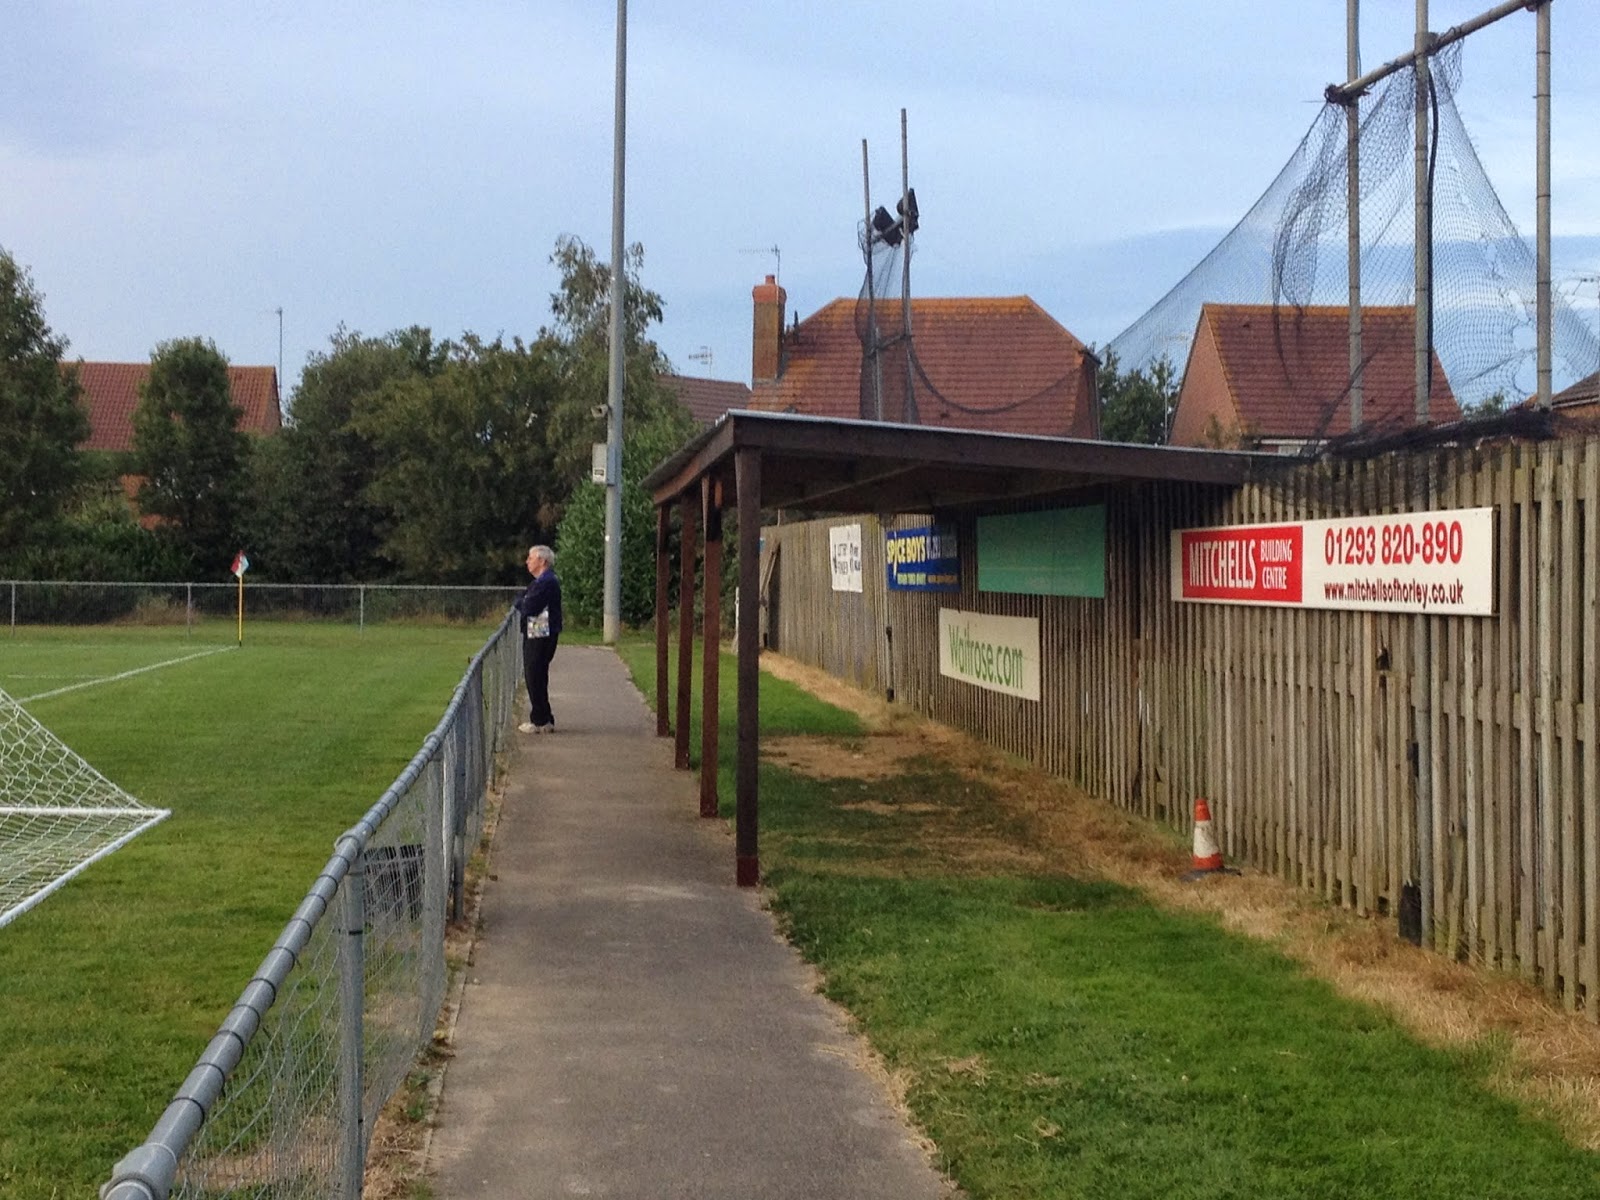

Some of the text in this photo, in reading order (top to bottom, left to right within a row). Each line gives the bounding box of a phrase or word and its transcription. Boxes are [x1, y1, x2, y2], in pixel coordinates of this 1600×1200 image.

[906, 536, 926, 563] BOYS
[1260, 539, 1293, 562] BUILDING
[1325, 520, 1463, 565] 01293 820-890
[1189, 539, 1257, 590] MITCHELLS
[1262, 567, 1287, 590] CENTRE
[1324, 578, 1464, 610] www.mitchellsofhorley.co.uk
[948, 621, 1024, 690] Waitrose.com
